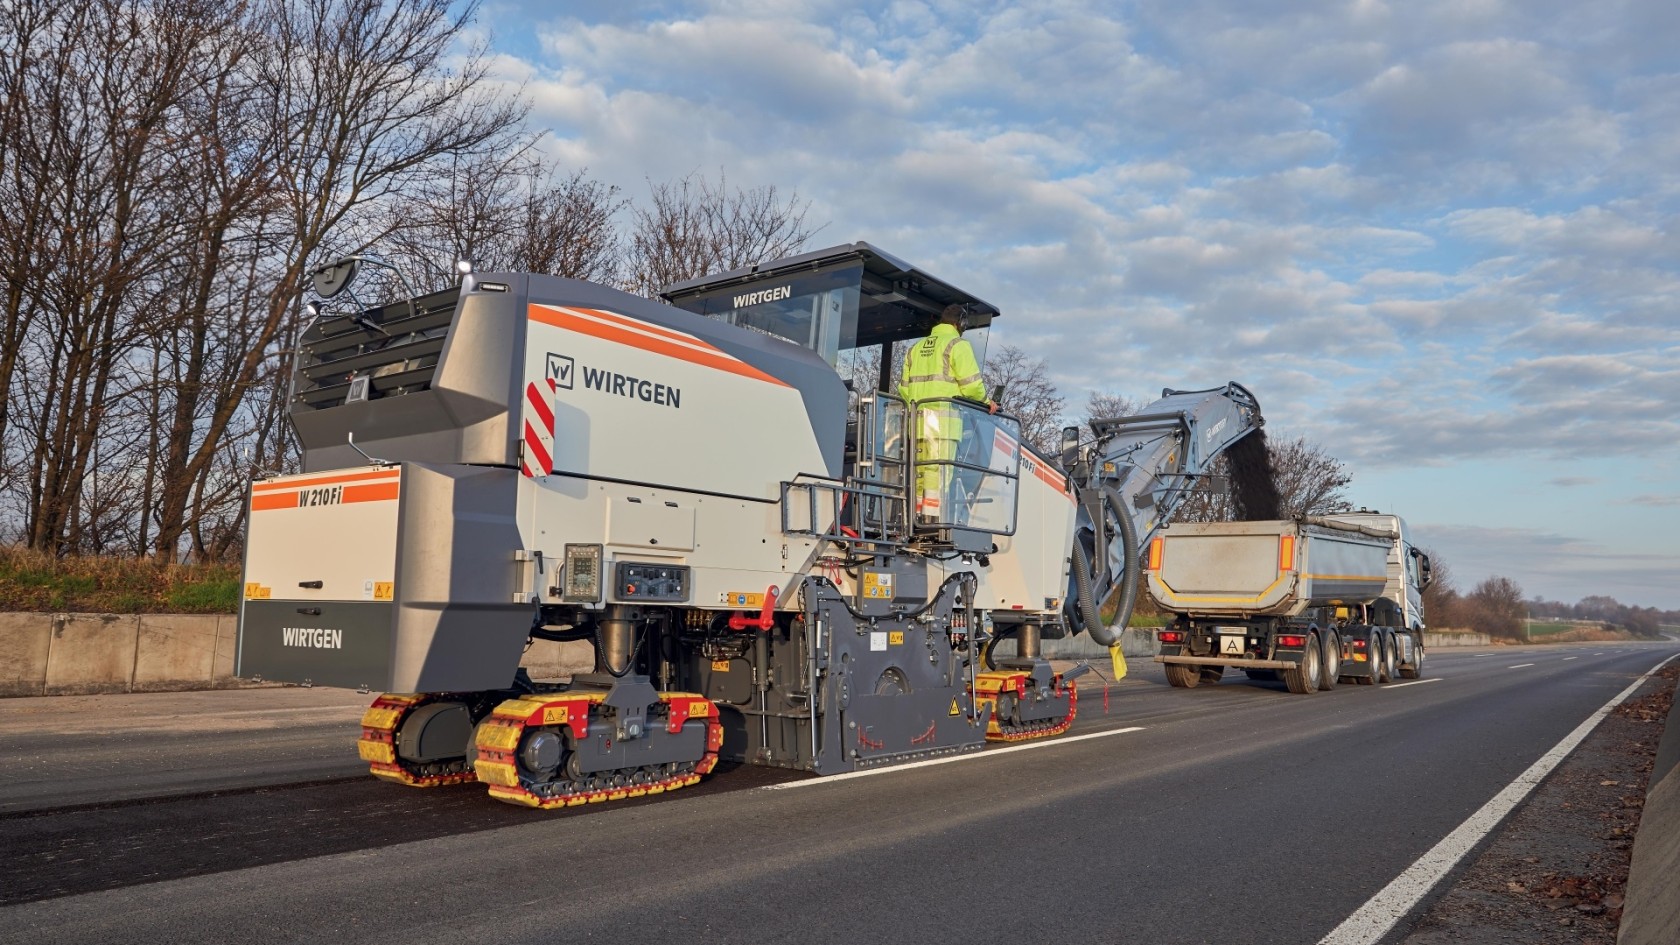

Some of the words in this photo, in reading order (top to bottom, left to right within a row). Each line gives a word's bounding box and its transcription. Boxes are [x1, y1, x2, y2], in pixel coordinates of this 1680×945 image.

[733, 285, 791, 308] WIRTGEN
[583, 366, 681, 409] WIRTGEN
[299, 490, 310, 507] W
[282, 627, 342, 649] WIRTGEN
[1226, 638, 1239, 652] A
